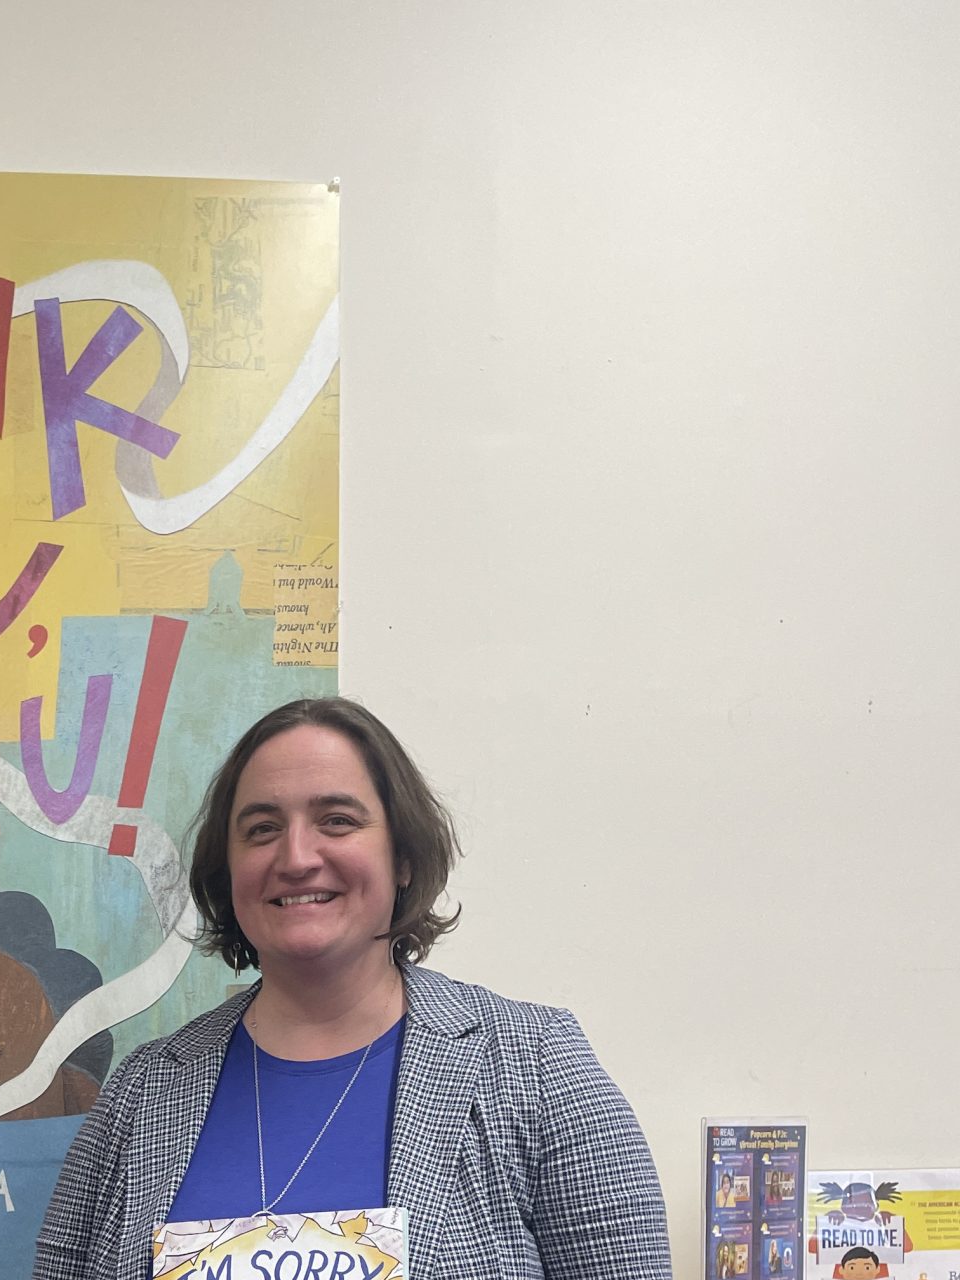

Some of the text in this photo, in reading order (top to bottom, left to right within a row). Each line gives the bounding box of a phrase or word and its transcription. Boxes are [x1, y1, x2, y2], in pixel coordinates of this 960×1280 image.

[277, 624, 315, 634] whence
[720, 1128, 734, 1137] READ
[713, 1137, 737, 1146] TO GROW
[822, 1229, 902, 1248] READ TO ME.
